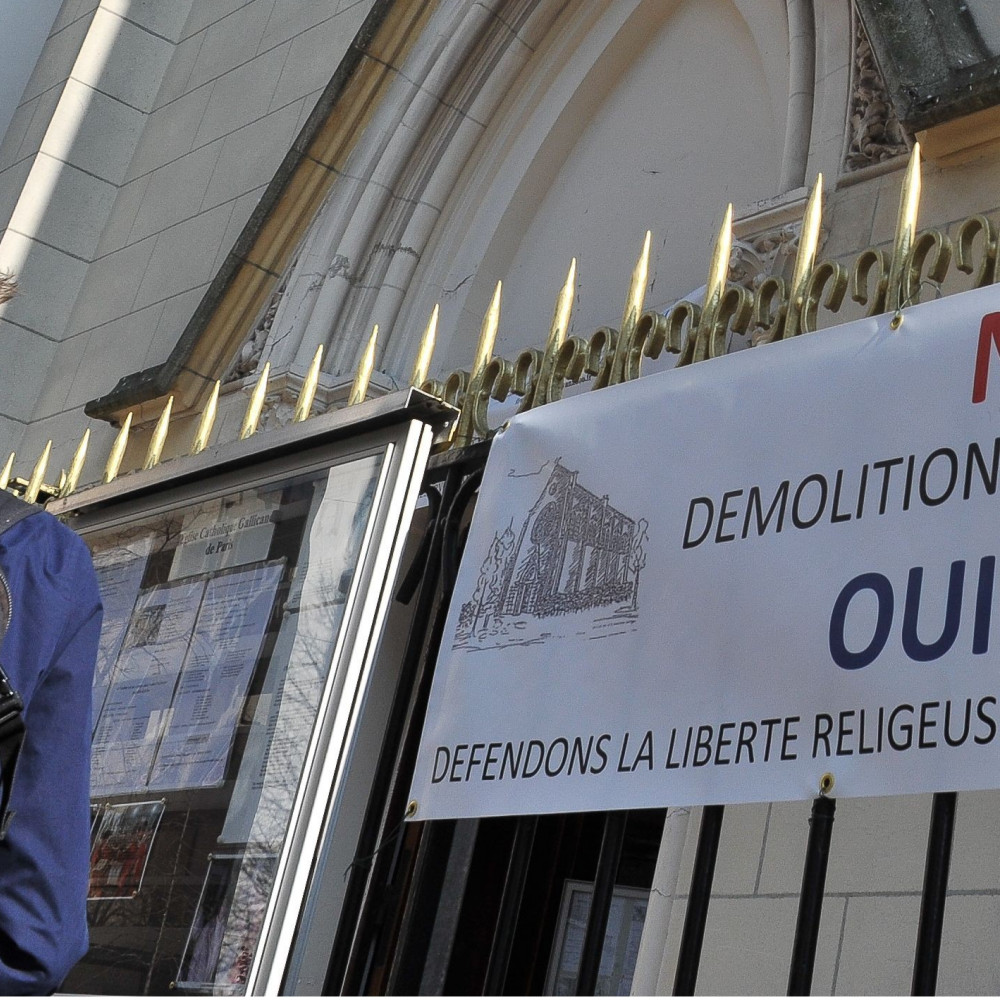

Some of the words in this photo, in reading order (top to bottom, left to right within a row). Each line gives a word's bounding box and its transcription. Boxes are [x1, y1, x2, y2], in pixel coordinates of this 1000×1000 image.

[238, 512, 275, 530] Gallican
[215, 538, 233, 553] Paris
[829, 555, 996, 670] OUI
[431, 734, 612, 784] DEFENDONS
[616, 730, 654, 773] LA
[665, 715, 801, 769] LIBERTE
